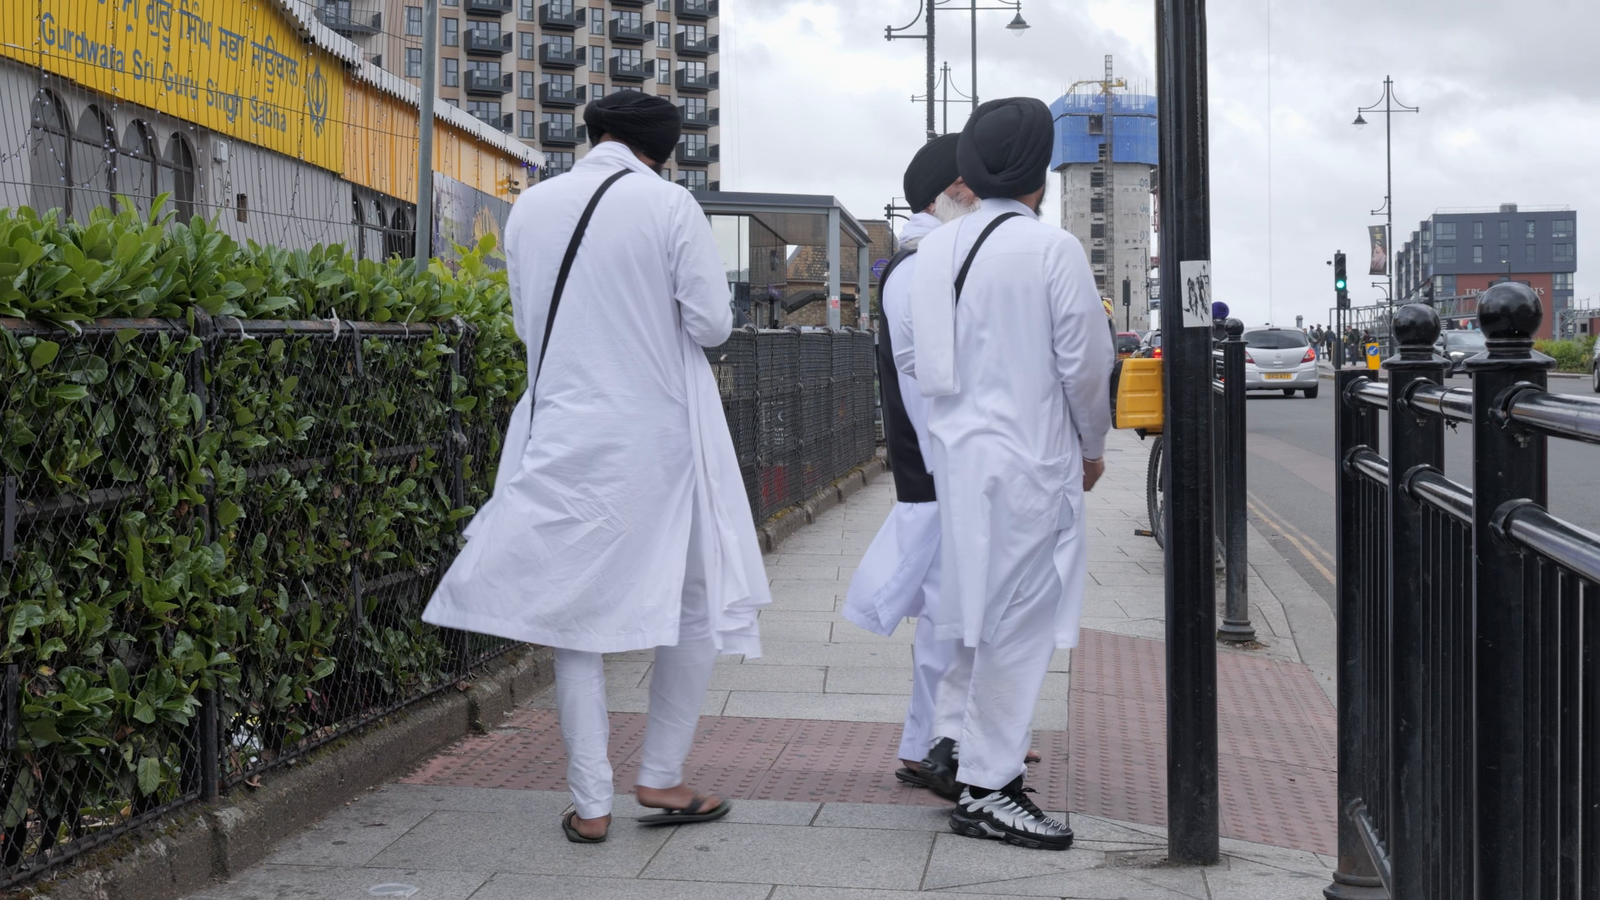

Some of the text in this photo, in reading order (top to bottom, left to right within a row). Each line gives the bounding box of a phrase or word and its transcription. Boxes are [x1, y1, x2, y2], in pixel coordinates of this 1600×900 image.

[41, 12, 125, 73] Gurdwara
[132, 48, 154, 85] Sri
[162, 61, 199, 101] Guru
[206, 77, 243, 123] Singh
[250, 95, 287, 133] Sabha
